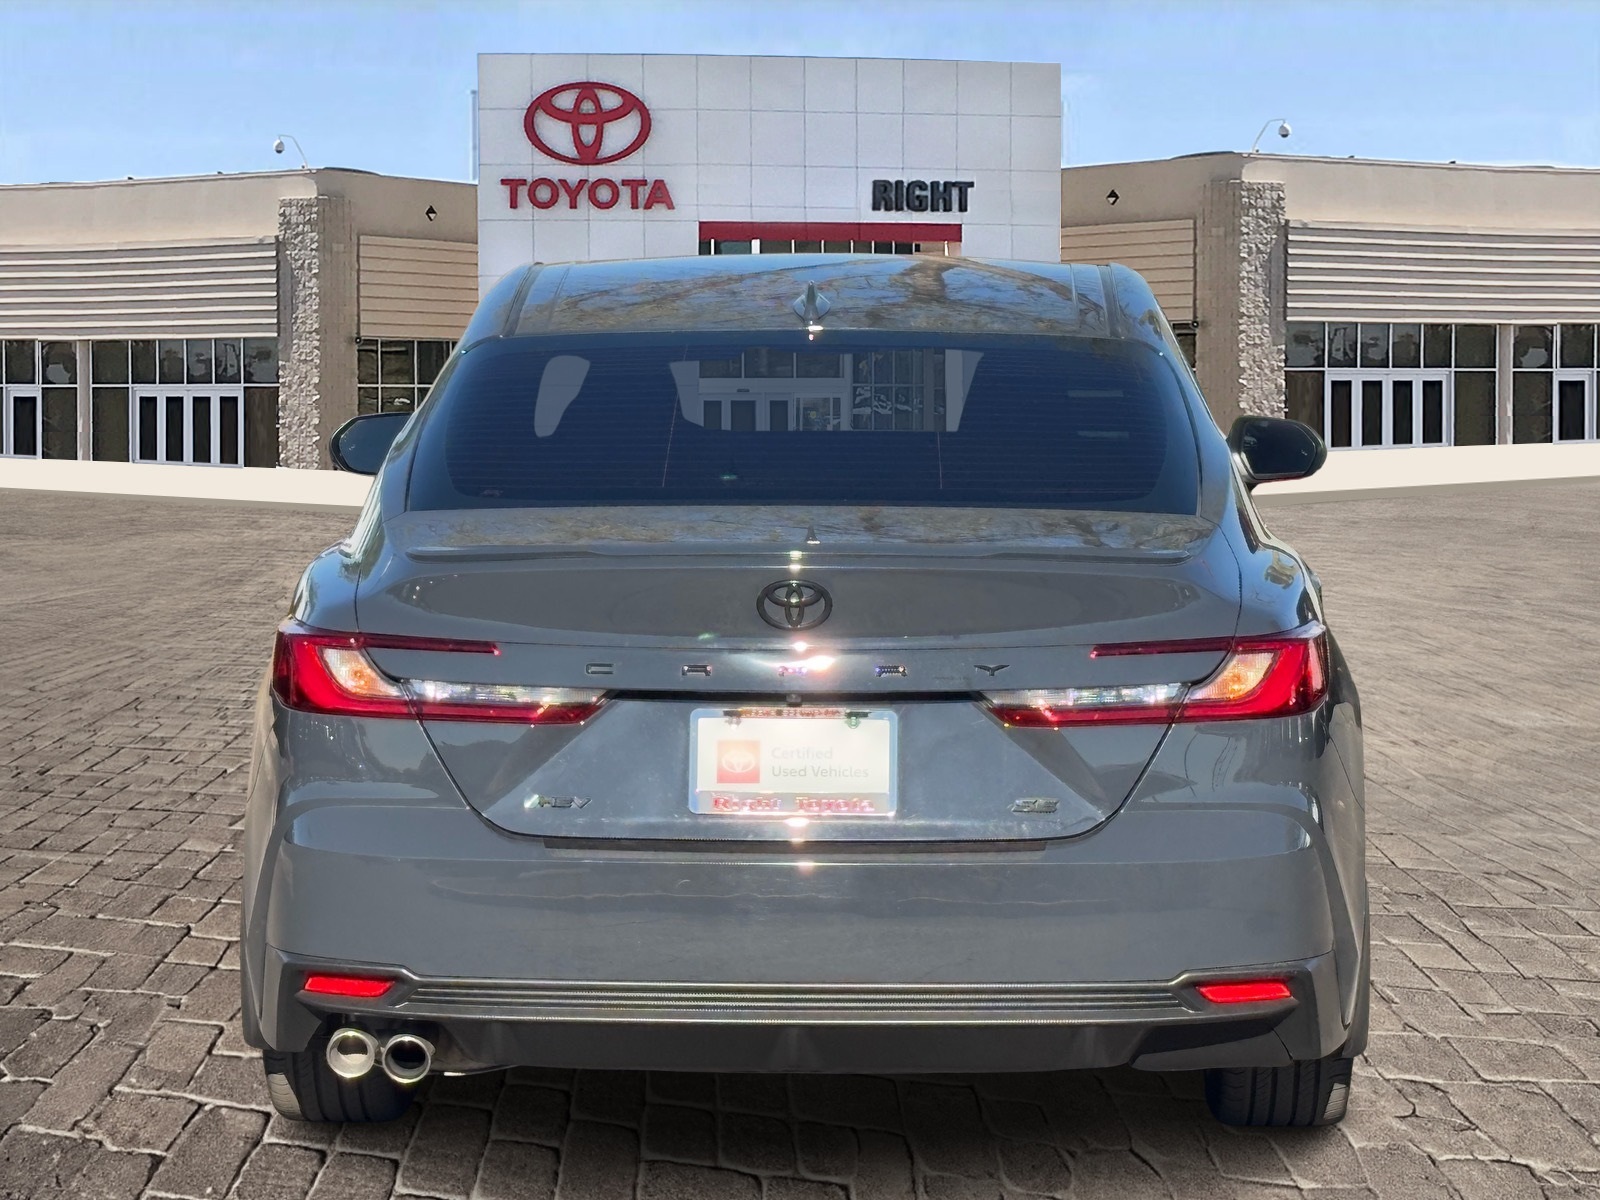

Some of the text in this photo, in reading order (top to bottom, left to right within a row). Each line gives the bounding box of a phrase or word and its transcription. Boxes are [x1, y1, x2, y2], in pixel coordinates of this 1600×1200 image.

[500, 178, 675, 210] TOYOTA
[872, 179, 976, 213] RIGHT
[771, 746, 833, 761] Certified
[771, 765, 869, 779] Used Vehicles
